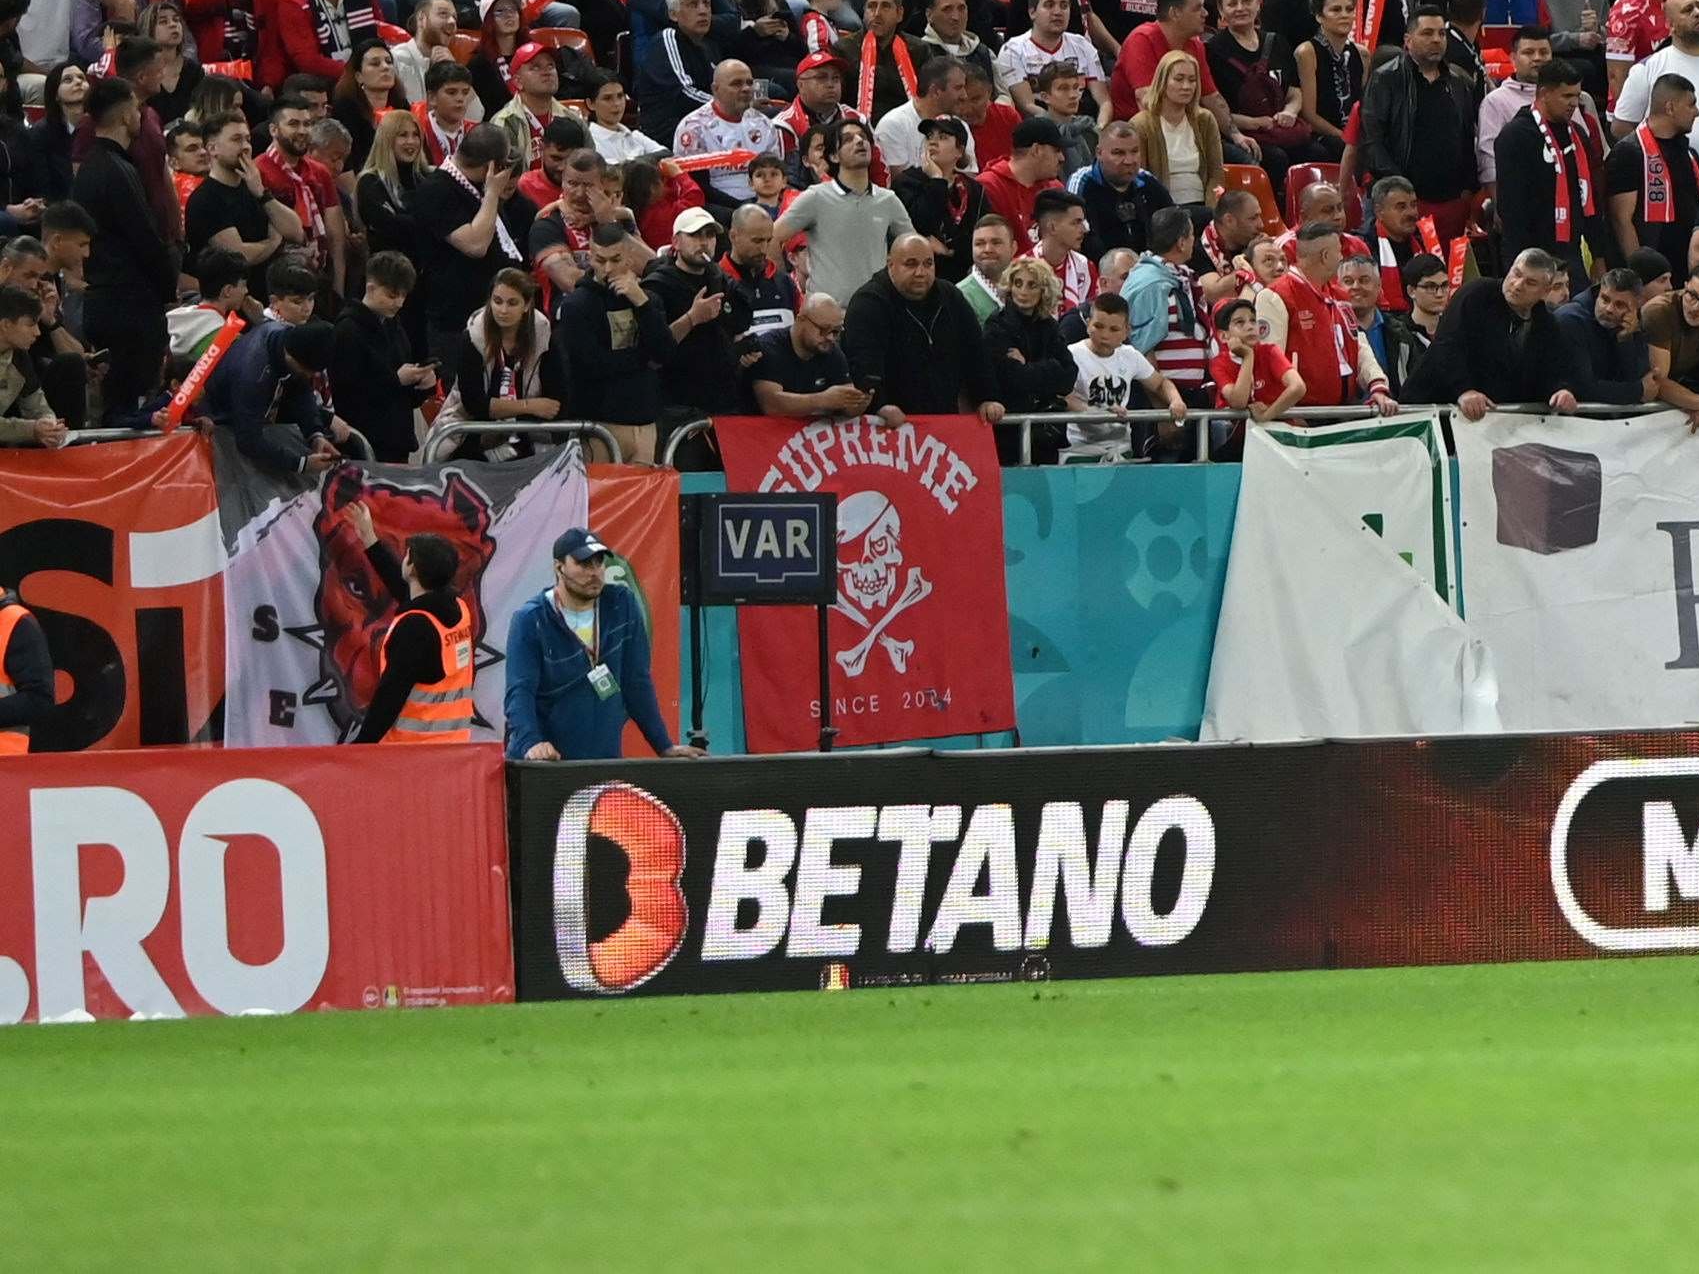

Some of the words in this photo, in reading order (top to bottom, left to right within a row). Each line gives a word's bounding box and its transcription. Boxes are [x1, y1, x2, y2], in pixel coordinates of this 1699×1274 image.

[176, 342, 221, 407] DINAMO
[724, 519, 813, 560] VAR
[251, 603, 282, 644] S
[268, 688, 299, 730] E
[810, 694, 881, 720] SNCE
[702, 794, 1217, 962] BETANO
